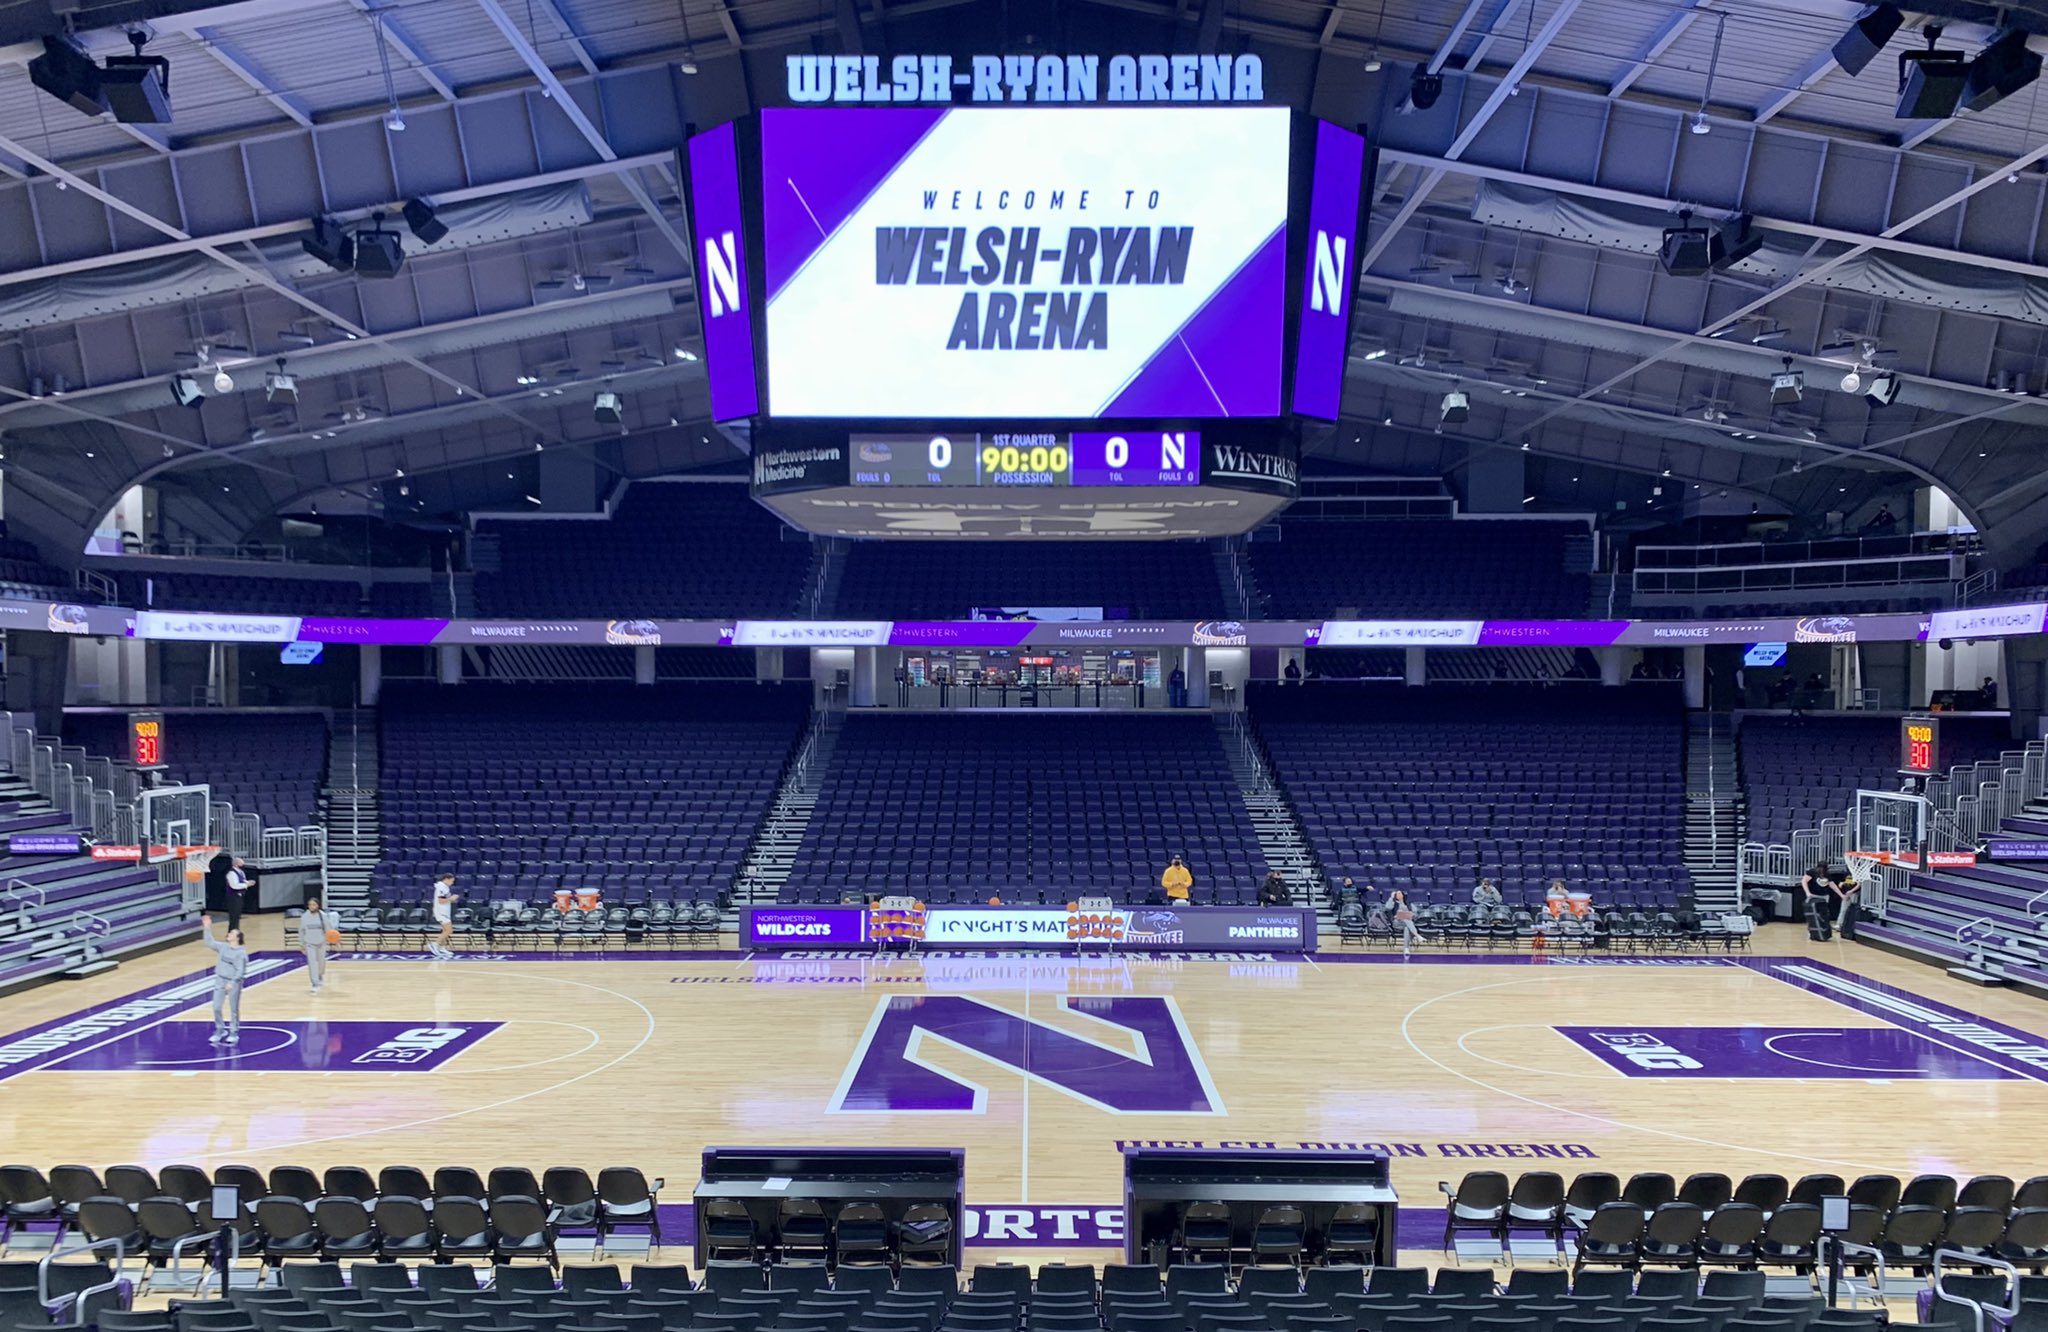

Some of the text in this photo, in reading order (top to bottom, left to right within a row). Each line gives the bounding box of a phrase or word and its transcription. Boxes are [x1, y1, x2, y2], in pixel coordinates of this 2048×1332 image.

[786, 54, 1264, 102] WELSH-RYAN ARENA
[922, 190, 1161, 210] WELCOME TO
[875, 226, 1193, 285] WELSH-RYAN
[704, 230, 741, 318] N
[1310, 229, 1347, 316] N
[945, 292, 1109, 351] ARENA
[992, 434, 1056, 446] 1ST QUARTER
[765, 447, 840, 467] Northwestern
[928, 436, 952, 468] 0
[982, 447, 1068, 473] 90:00
[1105, 436, 1129, 468] 0
[1161, 433, 1185, 469] N
[1214, 445, 1297, 481] WINTRUST
[765, 465, 806, 482] Medicine
[994, 472, 1054, 484] POSSESSION
[1109, 472, 1124, 482] TOL
[1158, 471, 1194, 482] FOULS 0
[471, 626, 526, 637] MILWAUKEE
[1059, 628, 1113, 638] MILWAUKEE
[1654, 628, 1710, 638] MILWAUKEE
[1907, 726, 1932, 742] 90:00
[137, 737, 158, 765] 30
[1910, 743, 1930, 769] 30
[756, 923, 832, 936] WILDCATS
[1257, 917, 1299, 925] MILWAUKEE
[1228, 926, 1299, 938] PANTHERS
[351, 952, 515, 962] WINTUST
[781, 951, 986, 960] CHICAGO'S
[1161, 952, 1278, 962] TEAM
[824, 993, 1229, 1117] N
[1436, 1143, 1602, 1159] ARENA
